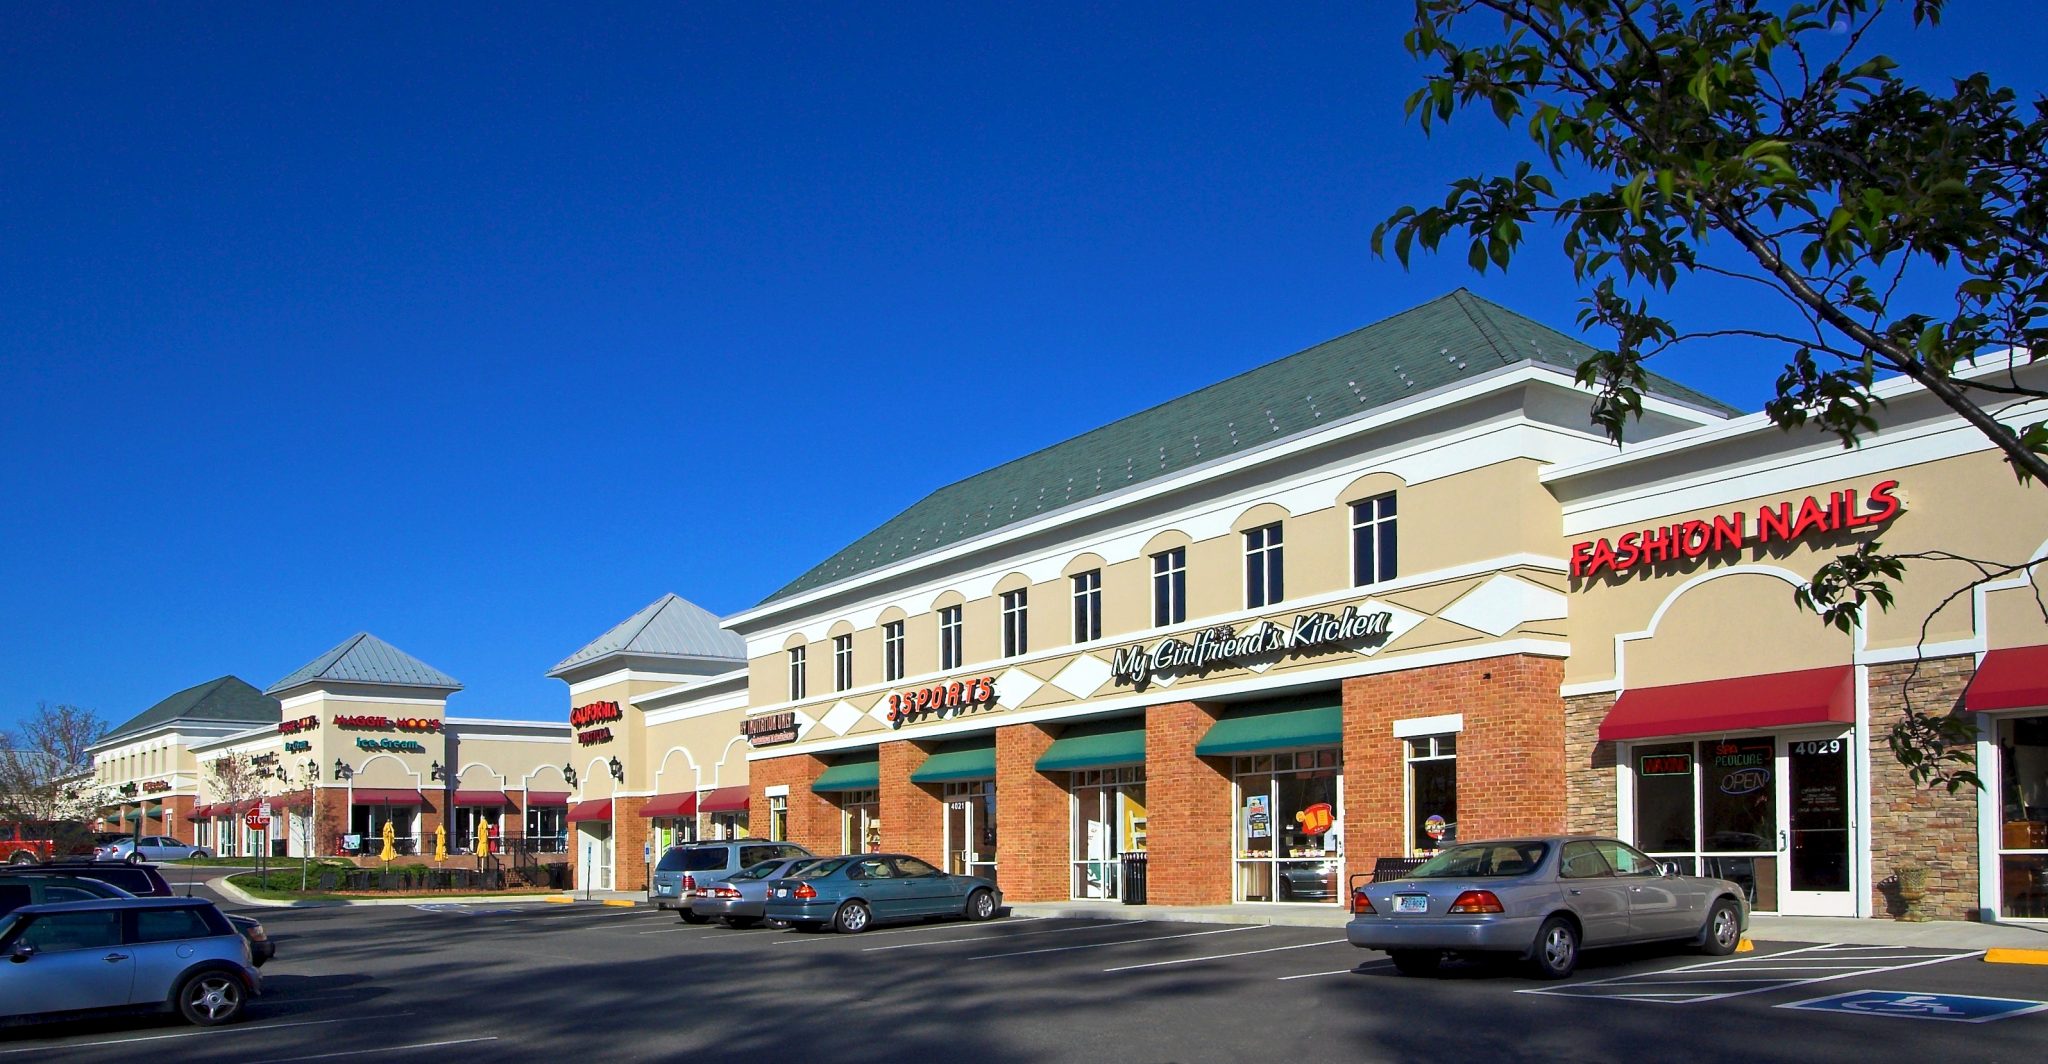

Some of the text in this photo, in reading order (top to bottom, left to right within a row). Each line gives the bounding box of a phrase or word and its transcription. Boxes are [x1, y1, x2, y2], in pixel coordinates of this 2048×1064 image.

[1571, 480, 1899, 577] FASHION NAILS
[1111, 606, 1391, 682] My Girlfriend's Kitchen
[333, 714, 387, 727] MAGGIE
[571, 701, 619, 727] CALIFORNIA
[356, 737, 419, 749] Ice Cream
[1796, 740, 1840, 755] 4029
[1715, 753, 1764, 767] PEDICURE
[1722, 772, 1766, 790] OPEN
[951, 802, 965, 811] 4021
